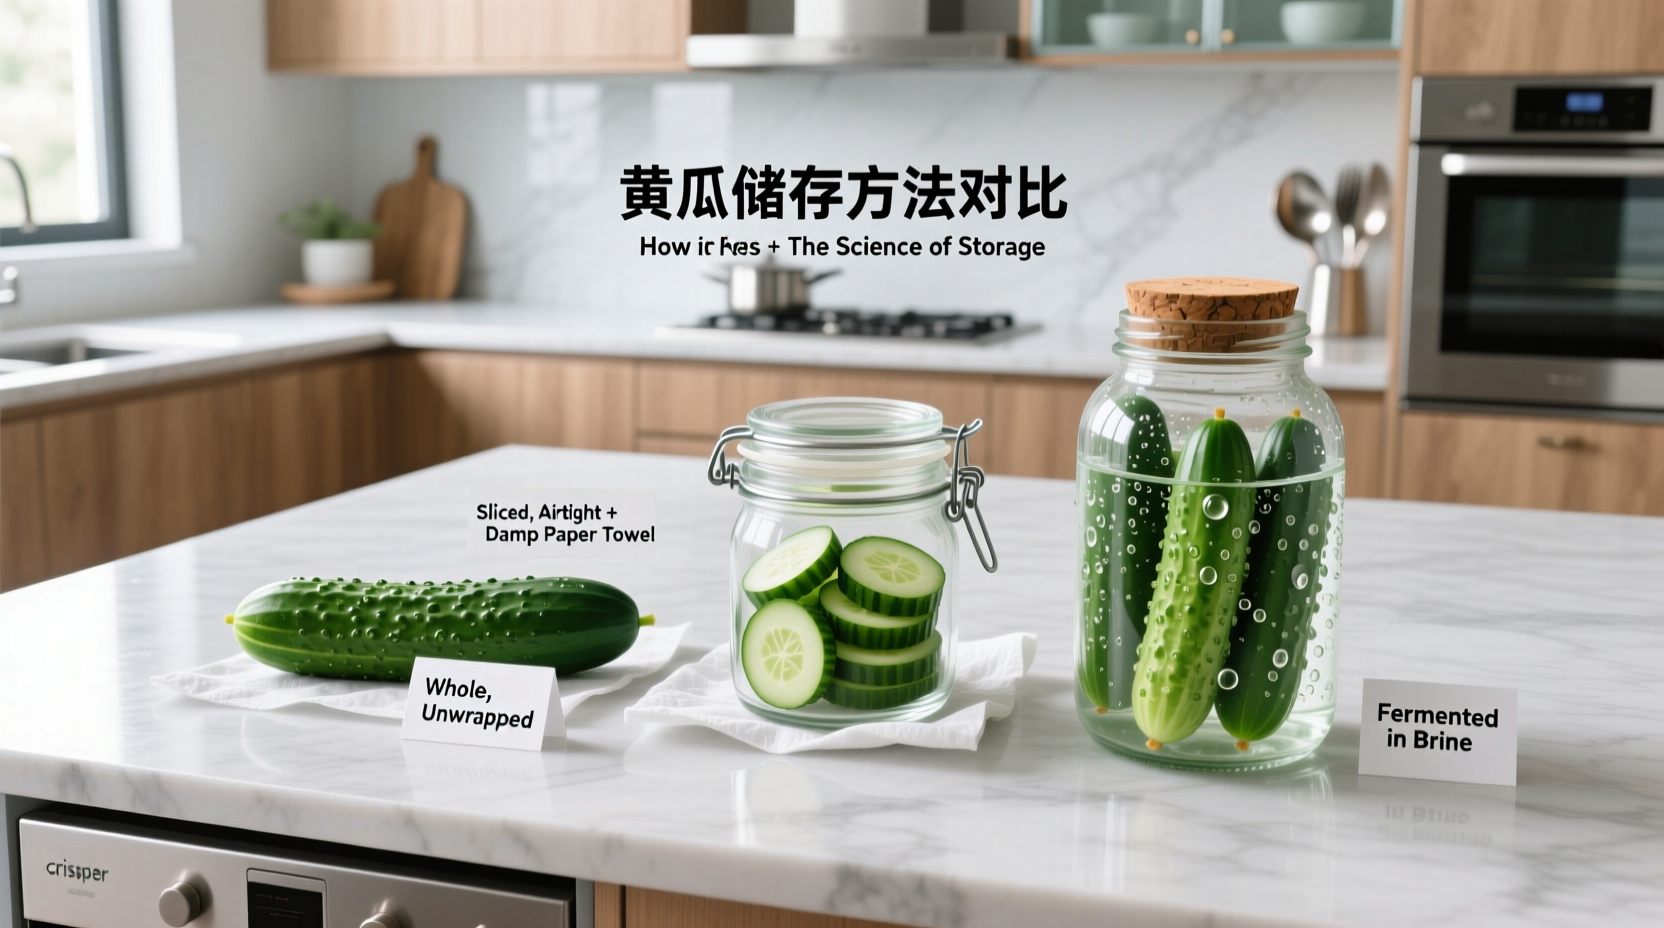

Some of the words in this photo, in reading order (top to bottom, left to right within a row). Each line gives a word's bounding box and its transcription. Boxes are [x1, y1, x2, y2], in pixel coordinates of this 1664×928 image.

[476, 502, 534, 523] Sliced,
[538, 503, 602, 525] Airtight
[606, 506, 618, 520] +
[486, 525, 539, 547] Damp
[544, 525, 598, 547] Paper
[601, 525, 655, 543] Towel
[425, 676, 492, 704] Whole,
[422, 703, 534, 731] Unwrapped
[1377, 702, 1499, 728] Fermented
[1387, 727, 1407, 749] in
[1413, 729, 1473, 752] Brine
